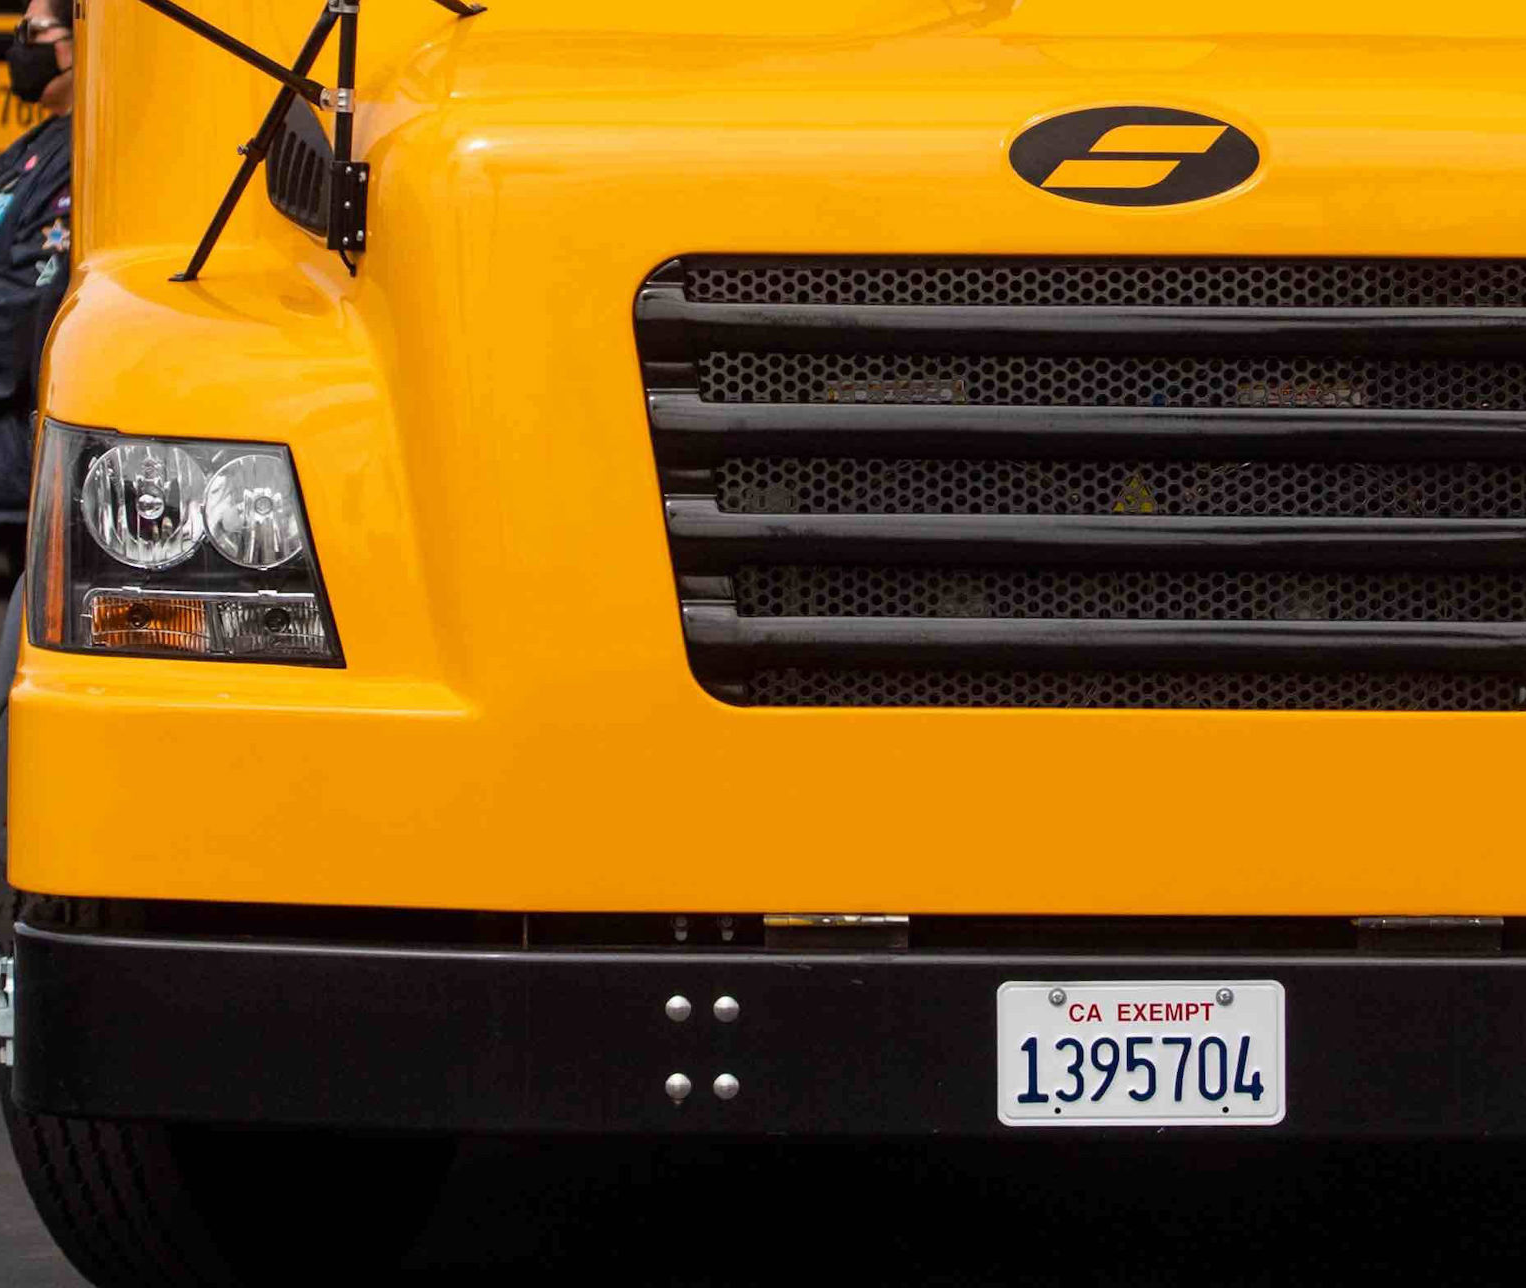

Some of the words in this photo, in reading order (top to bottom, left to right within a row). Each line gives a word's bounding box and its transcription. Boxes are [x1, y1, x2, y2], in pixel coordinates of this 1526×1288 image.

[1068, 1003, 1103, 1022] CA
[1116, 1002, 1215, 1022] EXEMPT
[1016, 1035, 1265, 1104] 1395704
